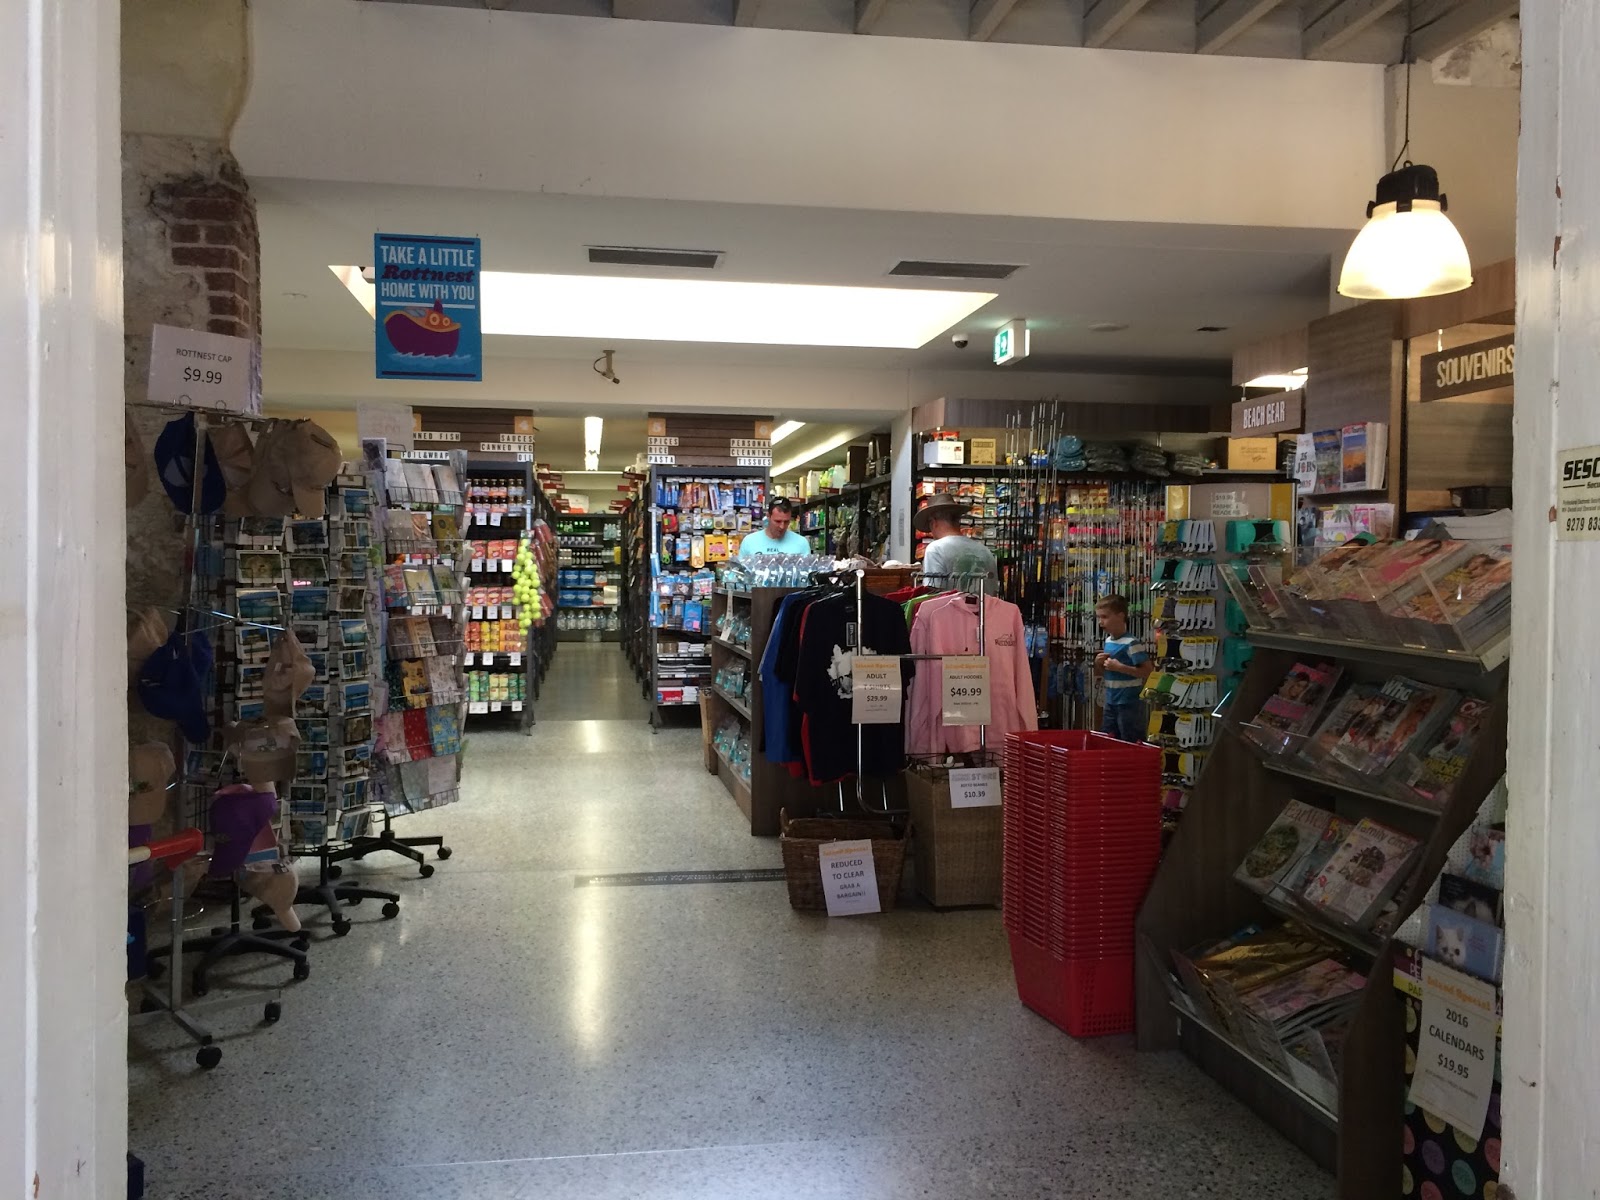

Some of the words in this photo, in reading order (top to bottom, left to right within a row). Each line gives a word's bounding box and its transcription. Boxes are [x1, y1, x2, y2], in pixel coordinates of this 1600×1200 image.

[380, 245, 415, 264] TAKE
[418, 247, 427, 265] A
[430, 247, 475, 267] LITTLE
[381, 264, 475, 283] Rottnest
[381, 282, 416, 298] HOME
[418, 283, 449, 299] WITH
[451, 285, 475, 300] YOU
[176, 348, 216, 361] ROTTNEST
[217, 354, 232, 363] CAP
[1436, 344, 1514, 388] SOUVENIRS
[183, 366, 223, 385] $9.99
[1243, 405, 1265, 429] BEACH
[1265, 401, 1286, 424] GEAR
[439, 433, 460, 441] FISH
[500, 435, 533, 443] SAUCES
[648, 438, 679, 446] SPICES
[731, 439, 772, 447] PERSONAL
[481, 443, 512, 451] CANNED
[517, 444, 533, 452] VEG
[648, 446, 668, 454] RICE
[731, 448, 772, 456] CLEANING
[738, 458, 772, 466] TISSUES
[1295, 461, 1316, 474] JOBS
[1566, 517, 1585, 531] 9279
[950, 687, 982, 698] $49.99
[1380, 680, 1413, 701] Who
[964, 790, 986, 799] $10.39
[831, 859, 863, 869] REDUCED
[843, 870, 865, 879] CLEAR
[1445, 1008, 1469, 1028] 2016
[1429, 1024, 1485, 1061] CALENDARS
[1437, 1053, 1469, 1079] $19.95
